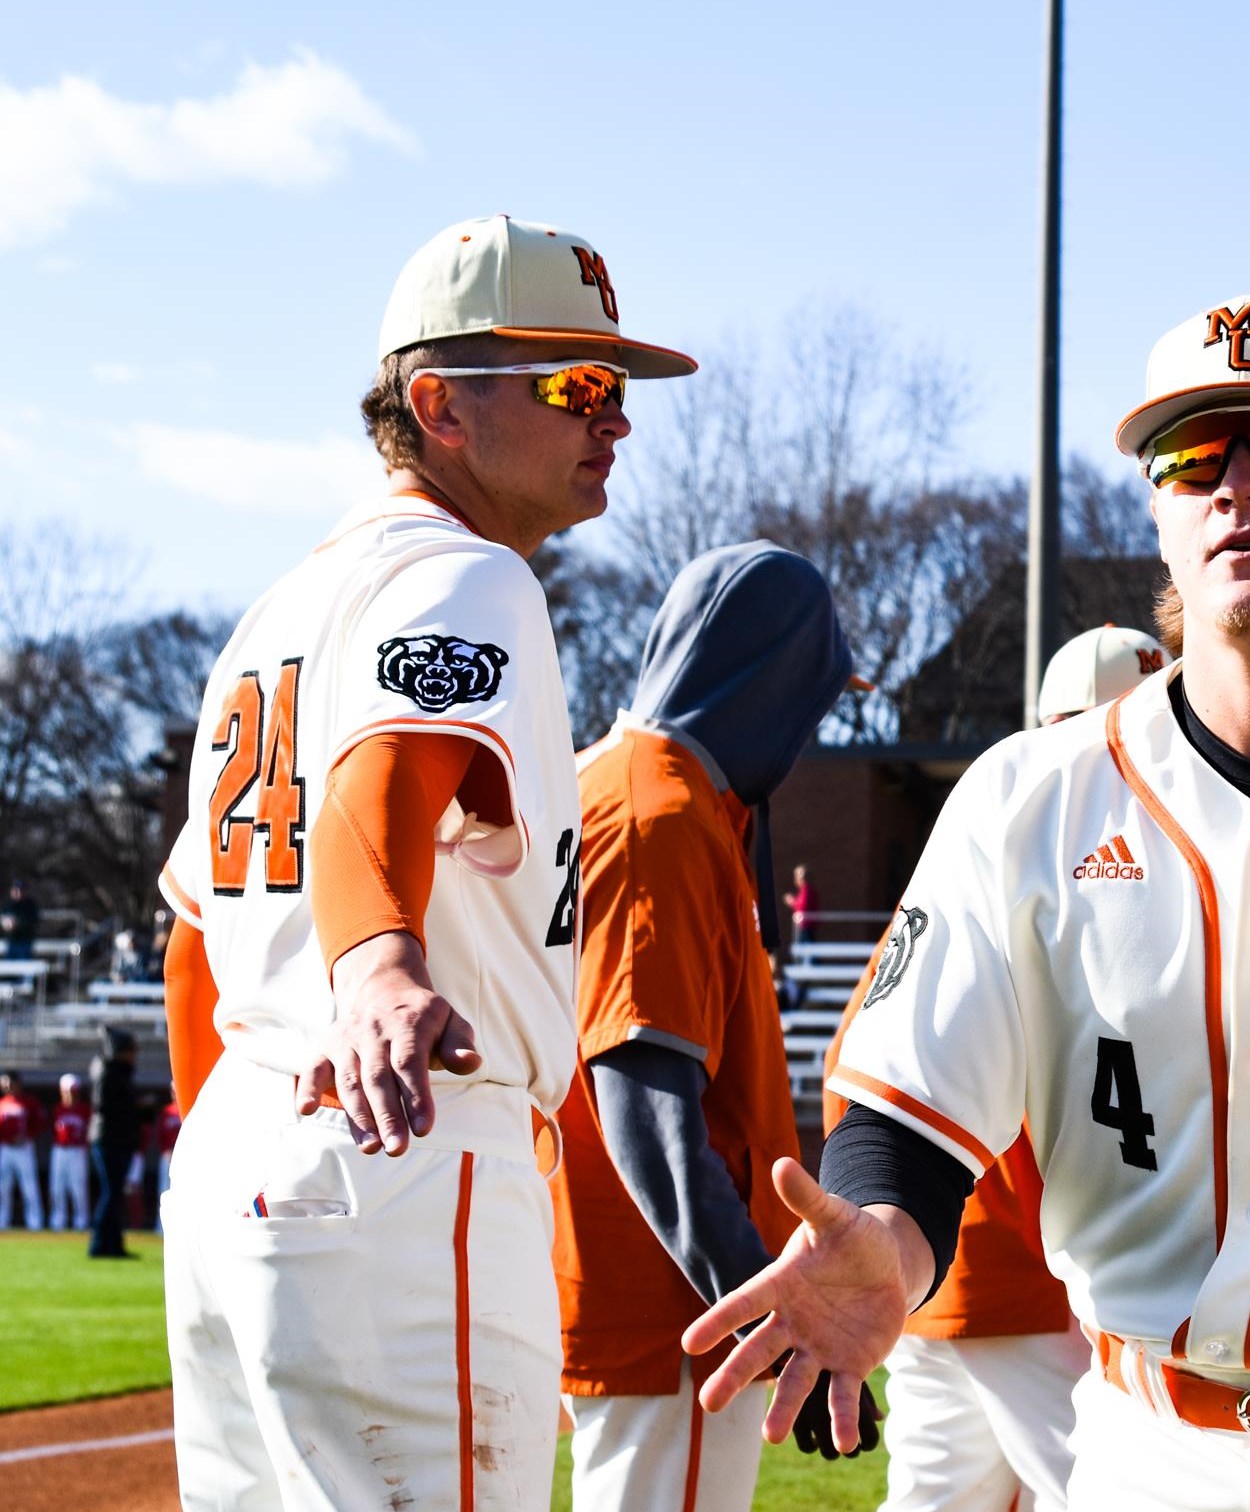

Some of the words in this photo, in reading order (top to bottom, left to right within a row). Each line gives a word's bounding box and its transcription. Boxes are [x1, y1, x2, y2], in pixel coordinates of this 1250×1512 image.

[209, 656, 306, 897] 24
[1073, 862, 1144, 880] adidas
[1091, 1036, 1158, 1171] 4
